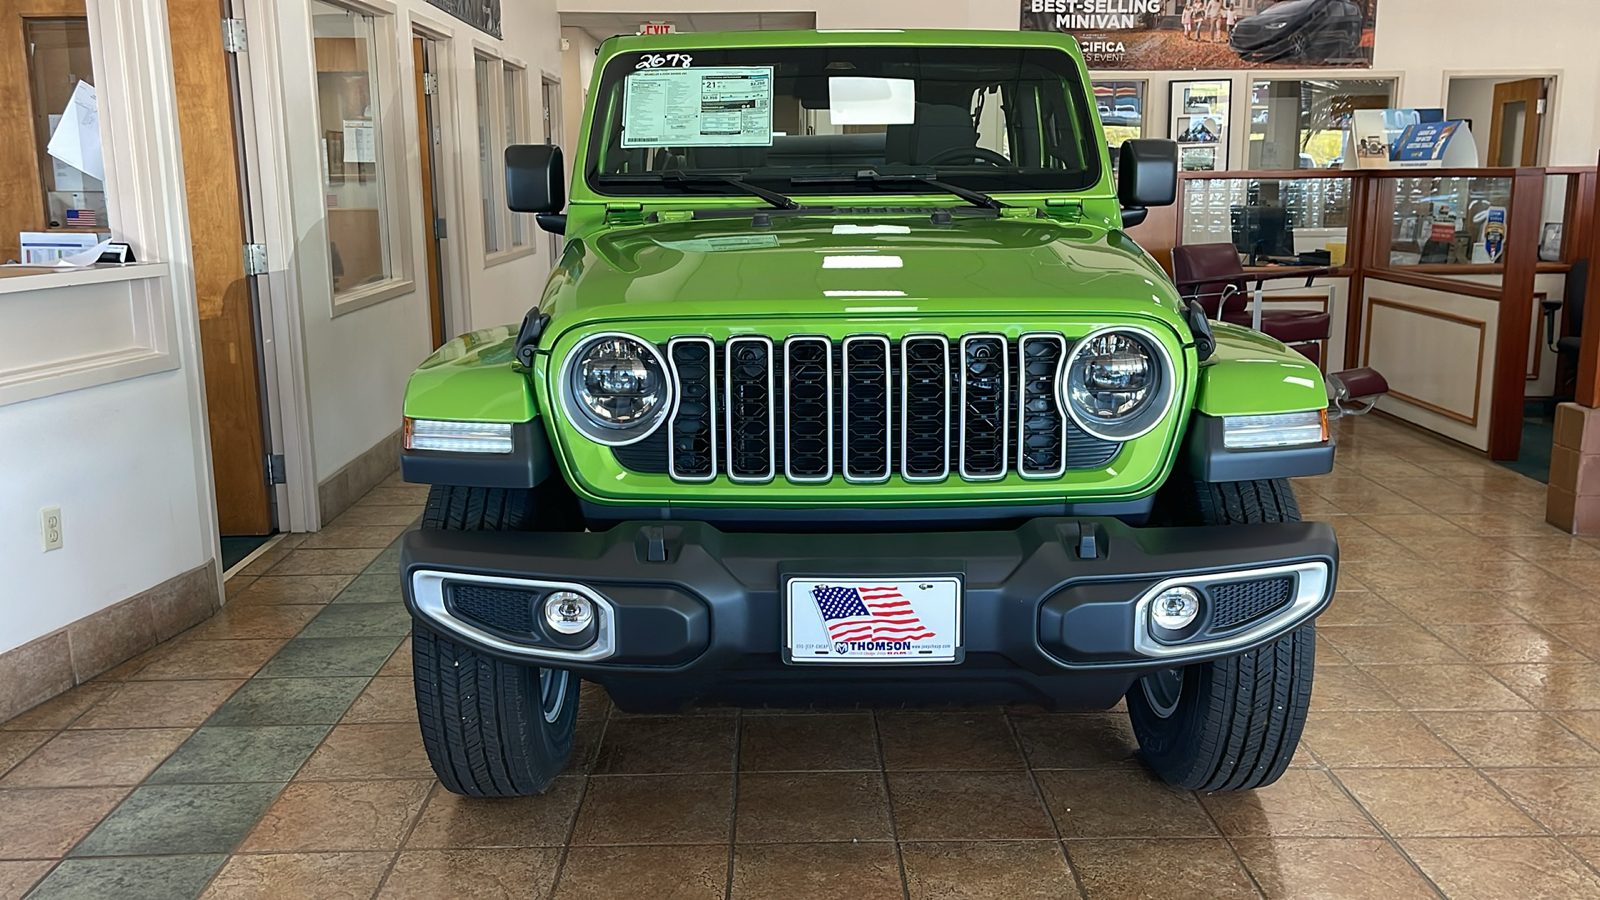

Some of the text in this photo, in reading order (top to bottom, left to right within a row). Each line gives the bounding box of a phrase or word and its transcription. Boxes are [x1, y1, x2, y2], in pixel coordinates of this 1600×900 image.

[1031, 0, 1160, 13] BEST-SELLING
[1056, 14, 1134, 29] MINIVAN
[1081, 41, 1126, 53] CIFICA
[635, 53, 693, 69] 2678
[1094, 53, 1126, 62] EVENT
[706, 81, 716, 89] 21
[849, 641, 911, 651] THOMSON
